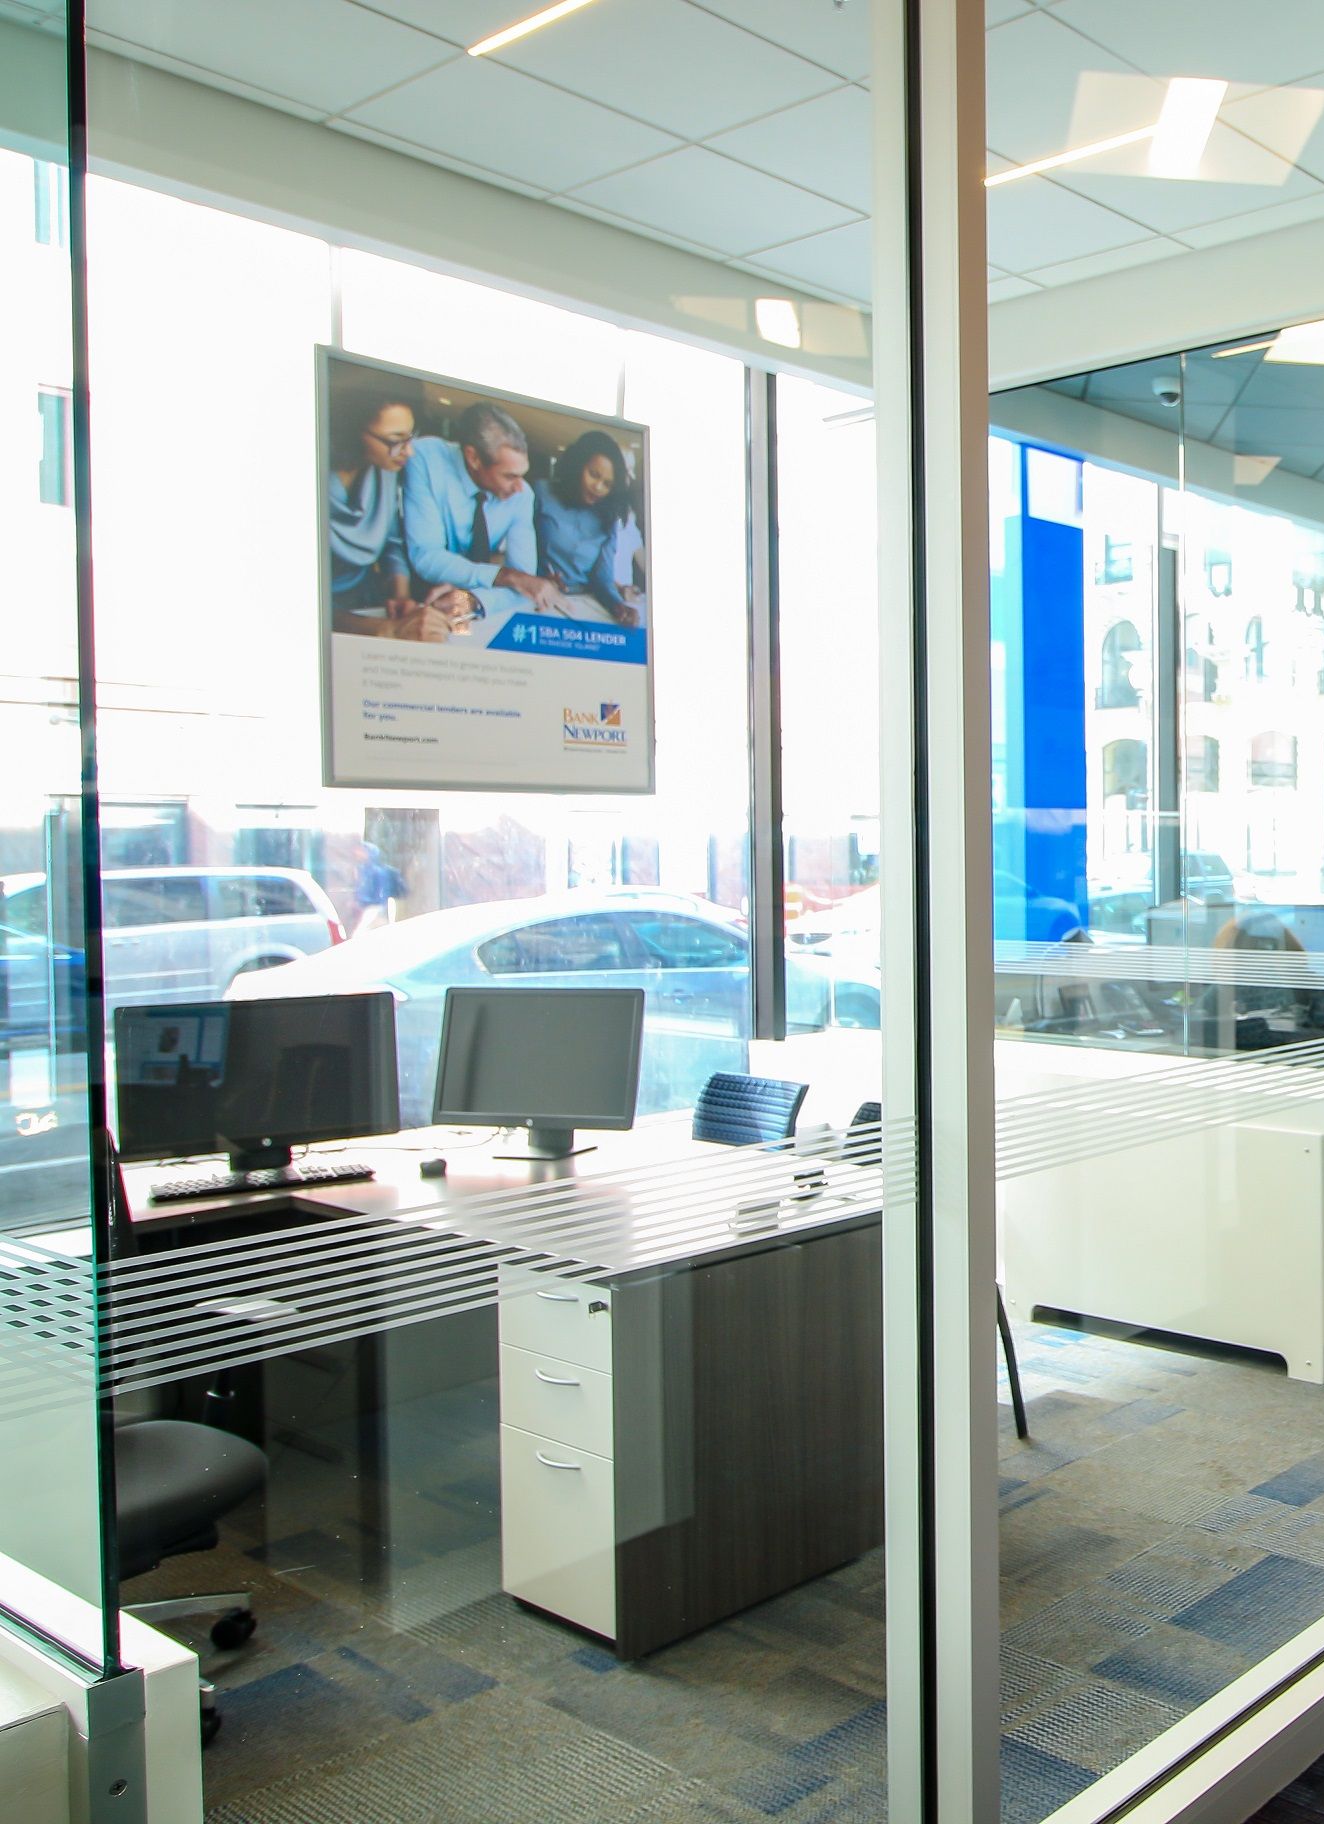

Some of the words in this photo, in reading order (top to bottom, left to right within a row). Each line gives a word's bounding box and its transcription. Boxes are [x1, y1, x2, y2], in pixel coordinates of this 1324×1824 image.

[512, 623, 537, 645] #1
[539, 626, 560, 639] SBA
[562, 628, 583, 642] 504
[584, 631, 626, 647] LENDER
[563, 723, 626, 742] NEWPORT
